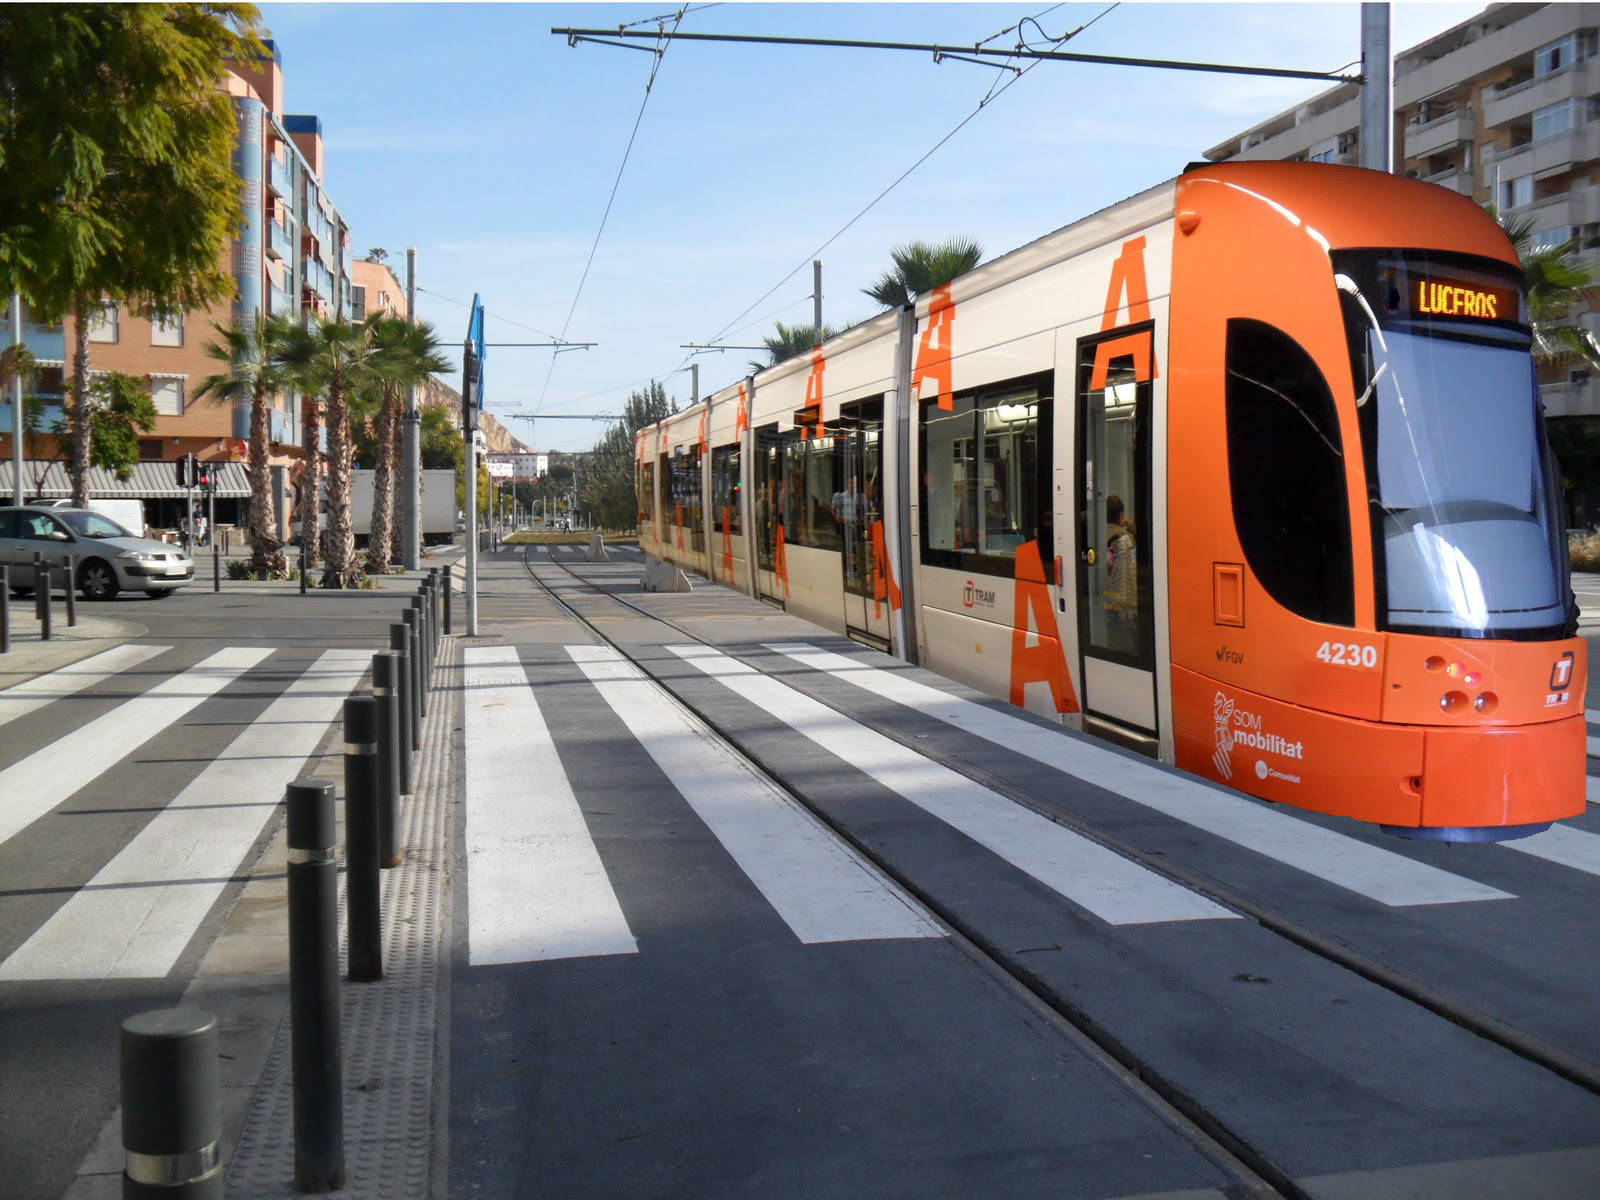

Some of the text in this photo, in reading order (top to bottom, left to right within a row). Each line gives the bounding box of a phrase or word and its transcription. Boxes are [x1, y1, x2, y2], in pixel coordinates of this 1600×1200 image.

[1419, 281, 1497, 318] LUCEROS
[974, 588, 996, 605] TRAM
[1225, 651, 1244, 665] FGV
[1316, 641, 1377, 668] 4230
[1233, 709, 1262, 731] SOM
[1233, 729, 1303, 760] mobilitat
[1268, 768, 1301, 784] Comunitat
